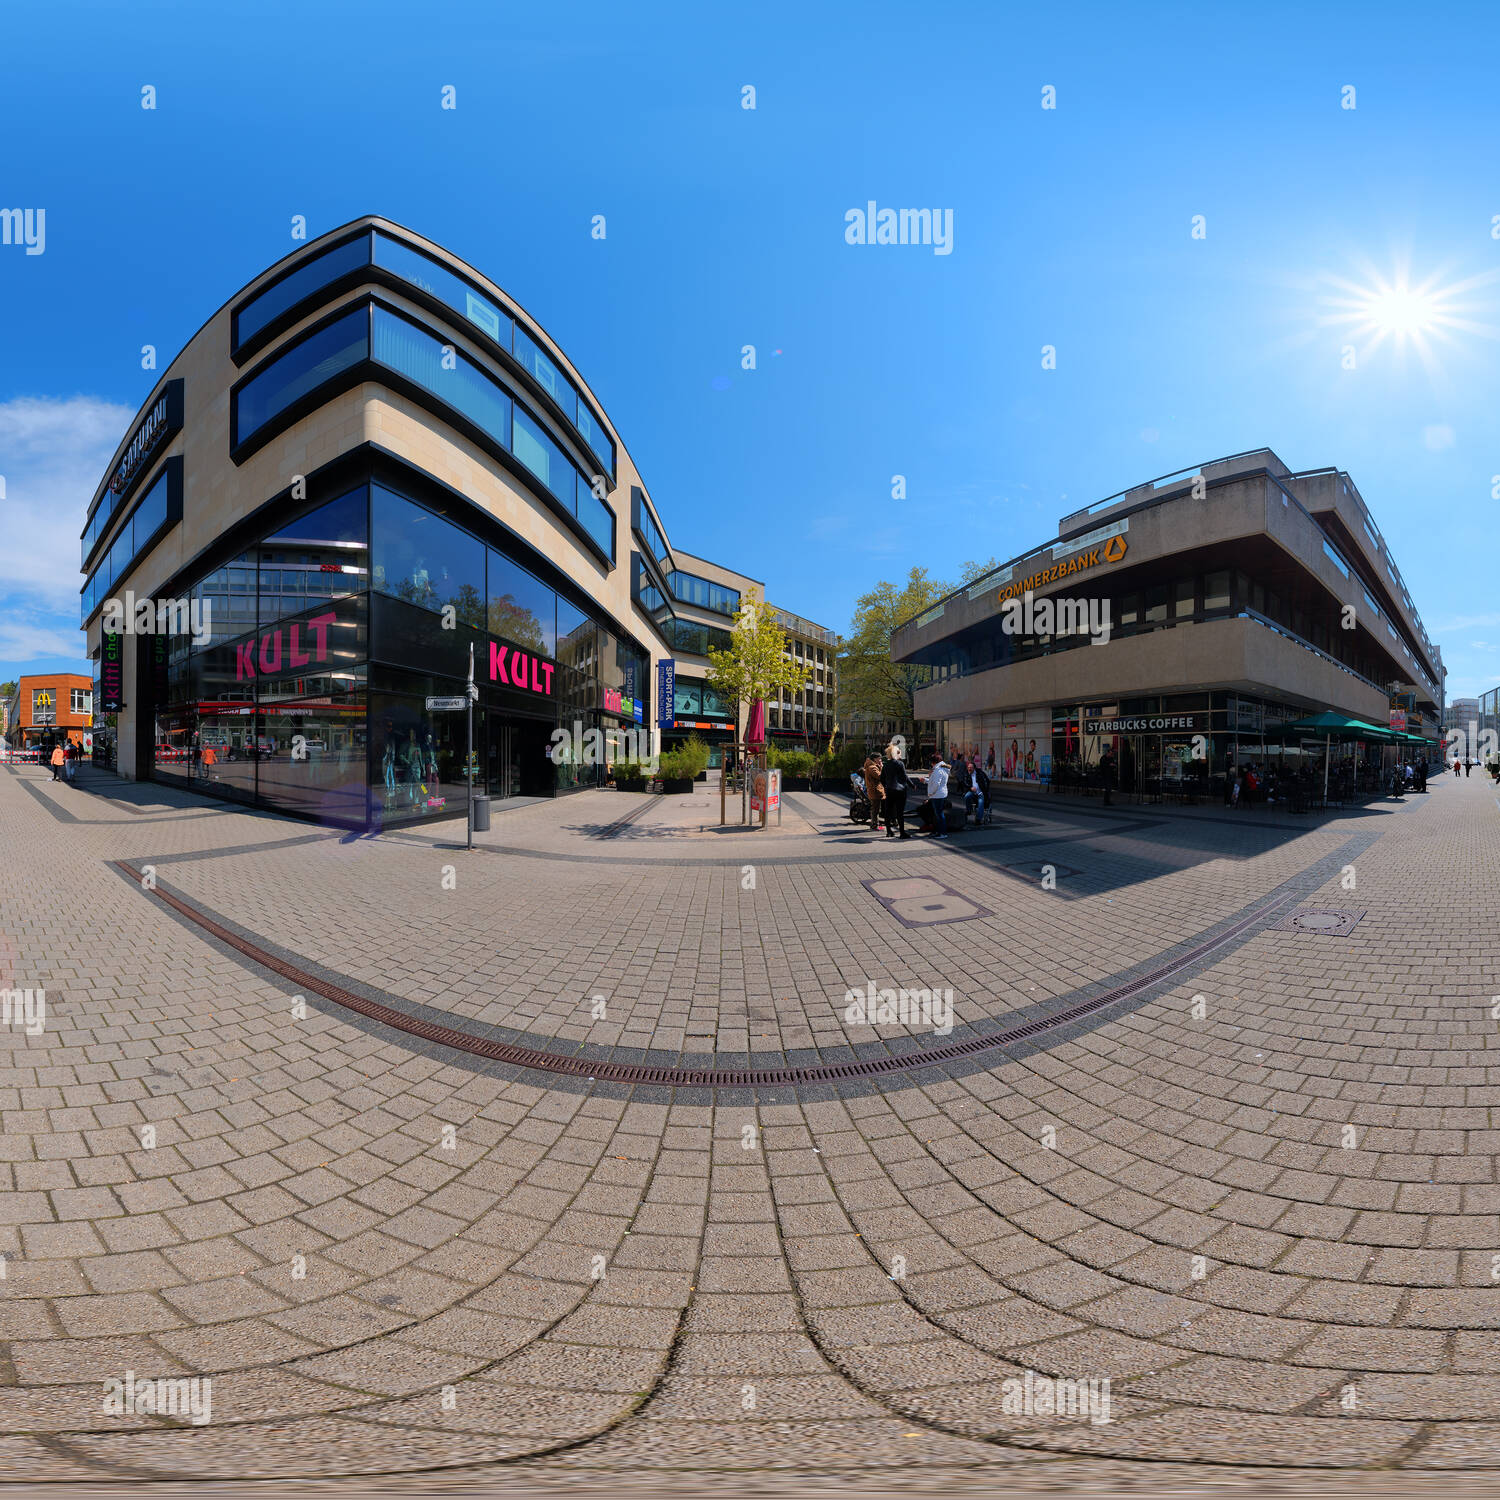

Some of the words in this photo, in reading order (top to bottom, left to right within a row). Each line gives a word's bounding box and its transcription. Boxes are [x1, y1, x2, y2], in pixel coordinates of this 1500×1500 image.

[122, 400, 166, 477] SATURN
[998, 549, 1100, 602] COMMERZBANK
[236, 611, 337, 681] KULT
[490, 641, 555, 695] KULT
[665, 666, 673, 721] SPORT-PARK
[1088, 720, 1147, 732] STARBUCKS
[1149, 717, 1194, 729] COFFEE
